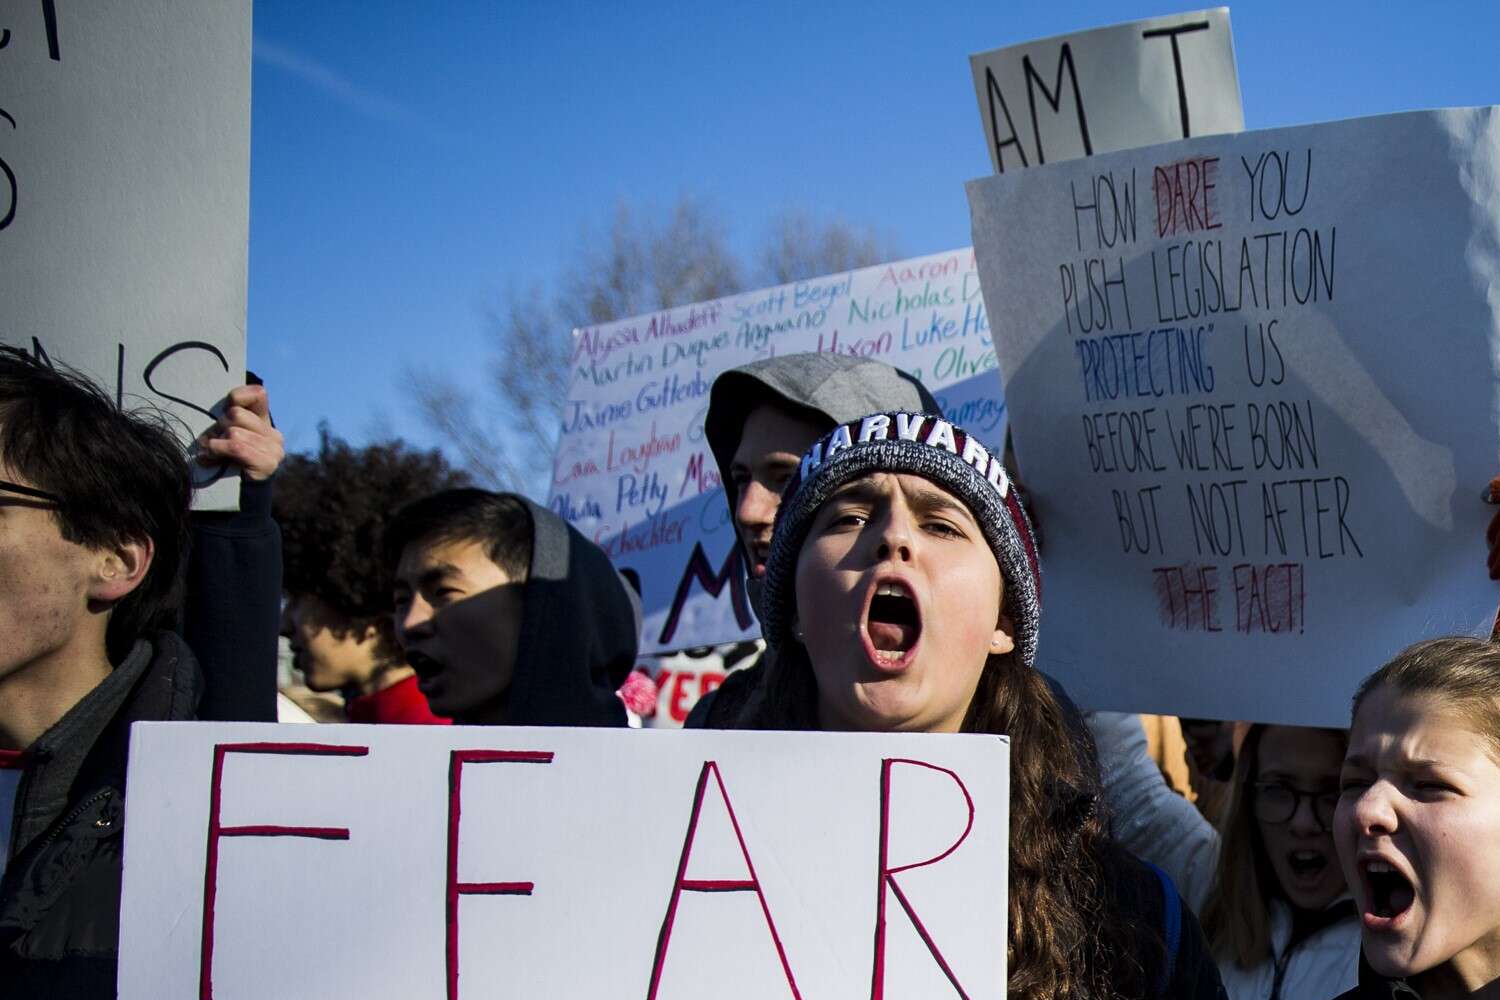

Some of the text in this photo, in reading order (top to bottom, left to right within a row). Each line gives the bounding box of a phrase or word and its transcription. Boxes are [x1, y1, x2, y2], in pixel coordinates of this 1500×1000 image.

[1070, 148, 1312, 251] HOW DARE YOU
[1059, 256, 1133, 335] PUSH
[1151, 226, 1337, 323] LEGISLATION
[901, 309, 960, 352] Luke
[1074, 319, 1286, 402] "PROTECTING" US
[801, 413, 1009, 500] HARVARD
[1082, 407, 1167, 473] BEFORE
[1248, 399, 1319, 471] BORN
[1112, 475, 1364, 559] BUT NOT AFTER
[1152, 562, 1306, 634] THE FACT!
